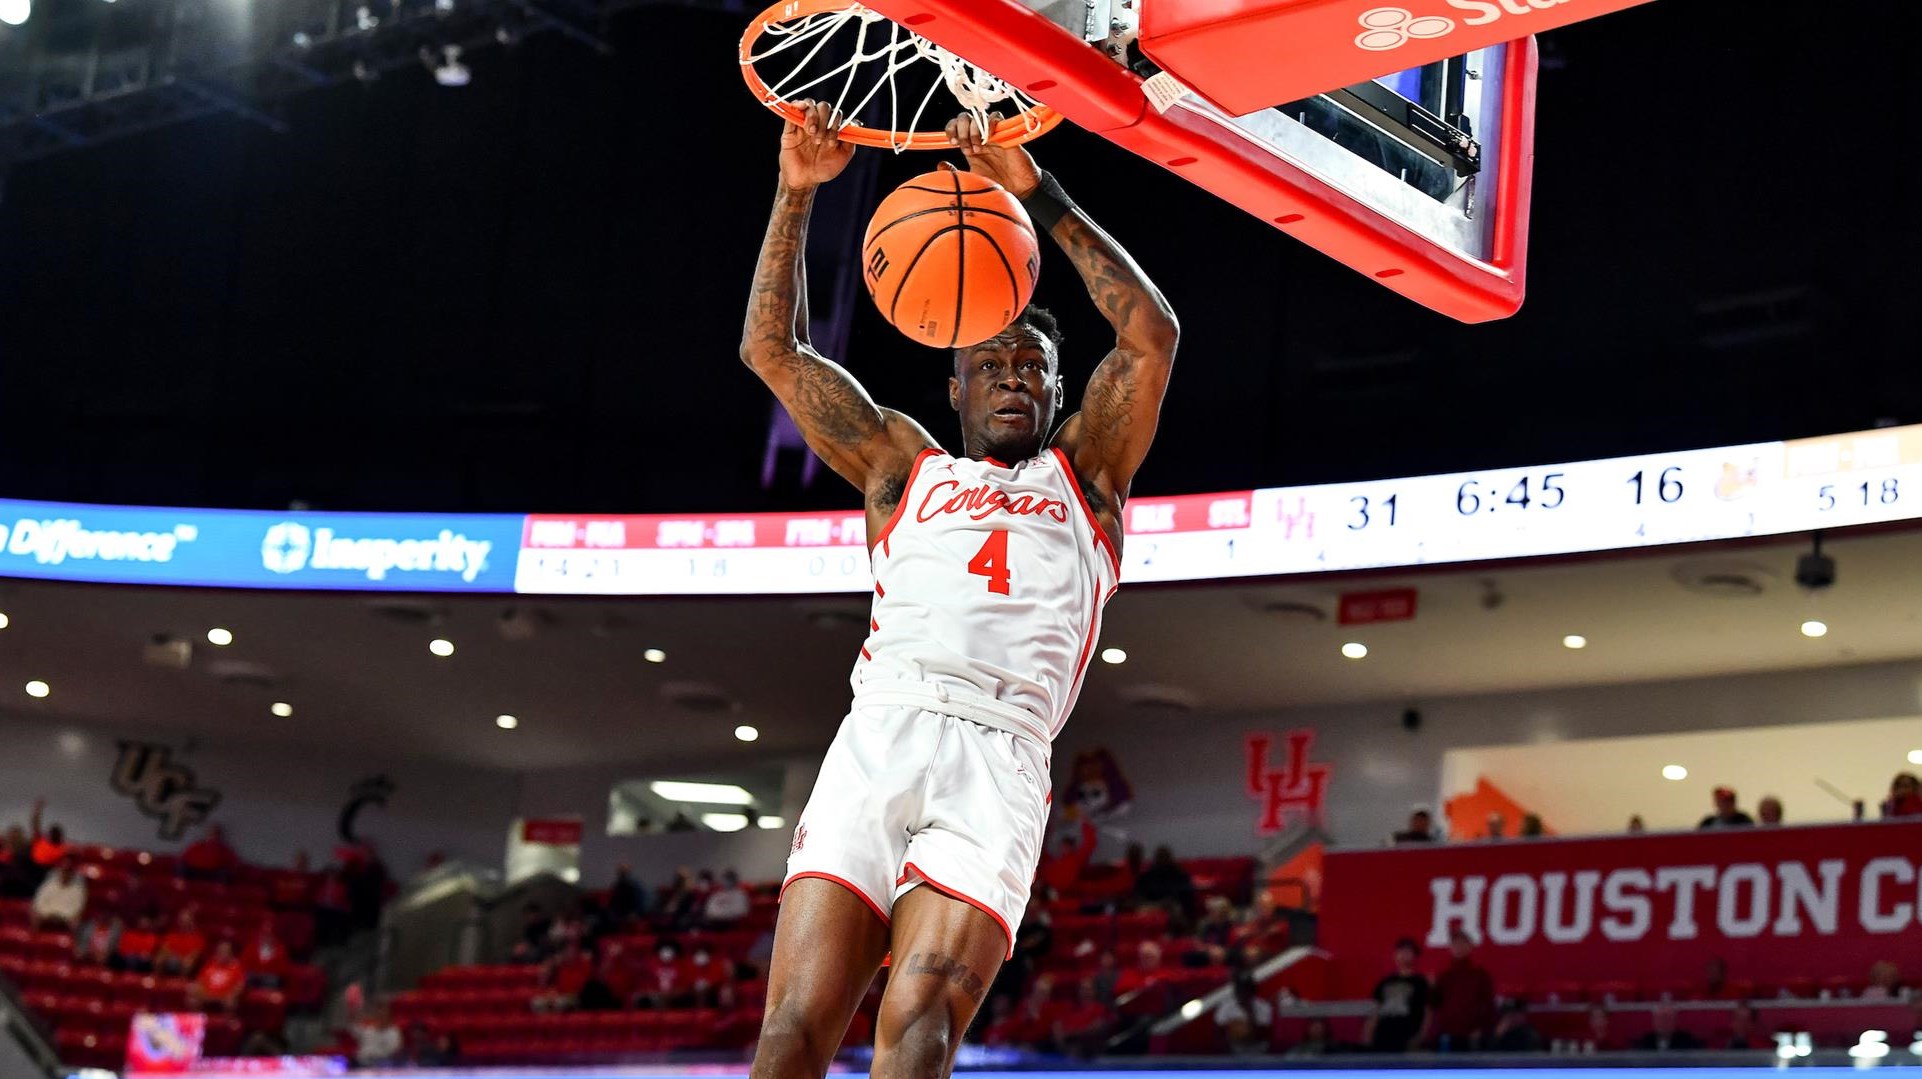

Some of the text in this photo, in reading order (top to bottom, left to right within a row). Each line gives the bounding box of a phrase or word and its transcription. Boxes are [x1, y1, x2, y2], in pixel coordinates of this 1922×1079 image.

[916, 479, 1068, 524] Cougars
[1457, 473, 1564, 515] 6:45
[1627, 467, 1683, 505] 16
[1819, 478, 1898, 511] 5 18
[1347, 494, 1397, 530] 31
[968, 529, 1011, 596] 4
[1245, 728, 1332, 837] UH
[1427, 856, 1922, 948] HOUSTON C
